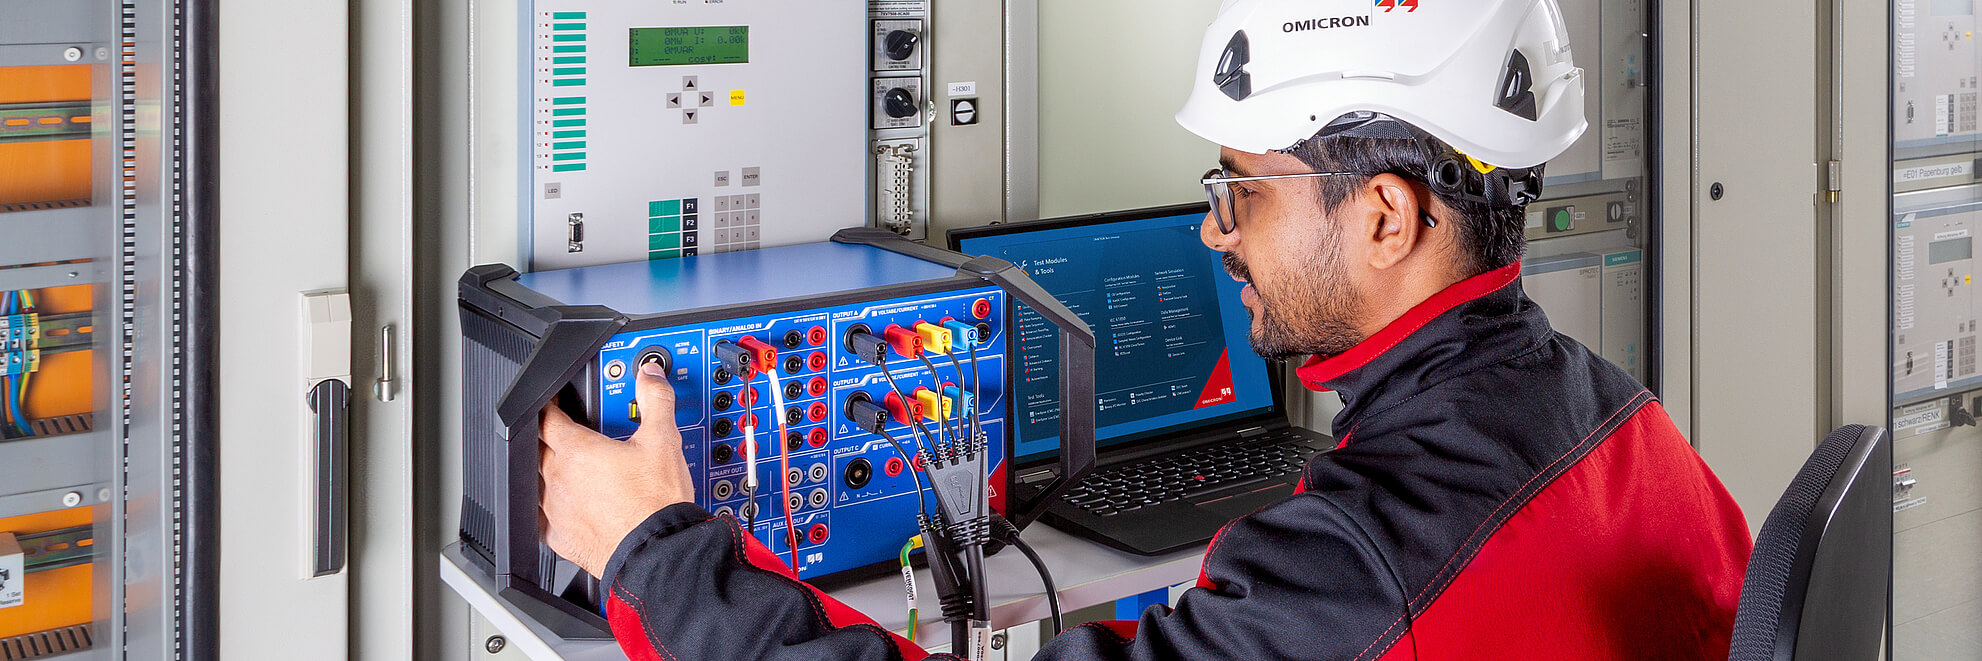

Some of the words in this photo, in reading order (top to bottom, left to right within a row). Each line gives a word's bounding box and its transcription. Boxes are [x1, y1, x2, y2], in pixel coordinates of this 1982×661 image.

[1282, 15, 1369, 33] OMICRON
[1919, 167, 1949, 177] Papenburg
[1045, 257, 1068, 265] Modules
[832, 311, 853, 319] OUTPUT
[877, 305, 919, 316] VOLTAGE/CURRENT
[708, 323, 755, 335] BINARY/ANALOG
[605, 382, 626, 390] SAFETY
[833, 379, 854, 387] OUTPUT
[833, 446, 855, 455] OUTPUT
[709, 469, 731, 478] BINARY
[731, 466, 743, 474] OUT
